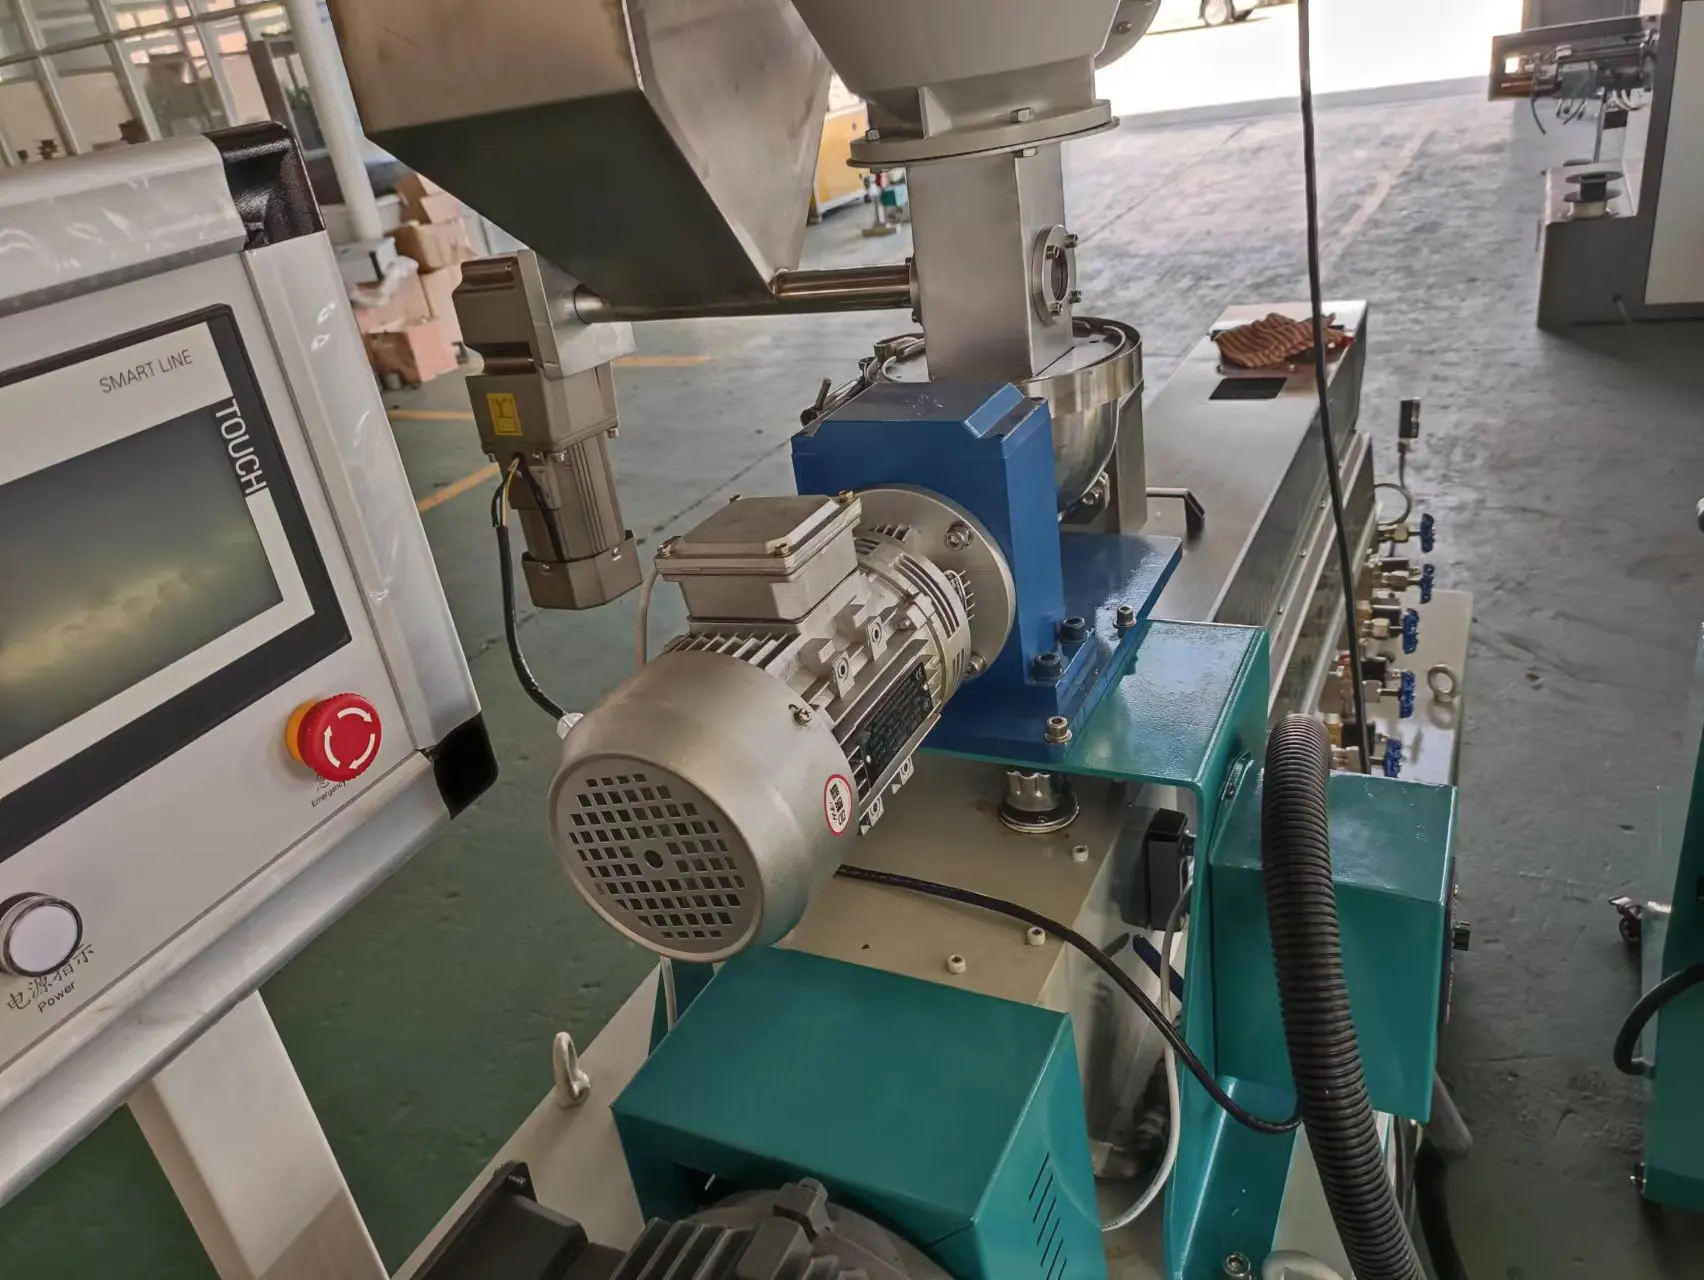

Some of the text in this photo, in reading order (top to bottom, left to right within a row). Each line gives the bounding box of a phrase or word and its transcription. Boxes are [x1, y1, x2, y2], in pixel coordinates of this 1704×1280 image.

[99, 349, 193, 393] SMART LINE
[215, 398, 267, 494] TOUCH
[37, 981, 76, 1014] Power
